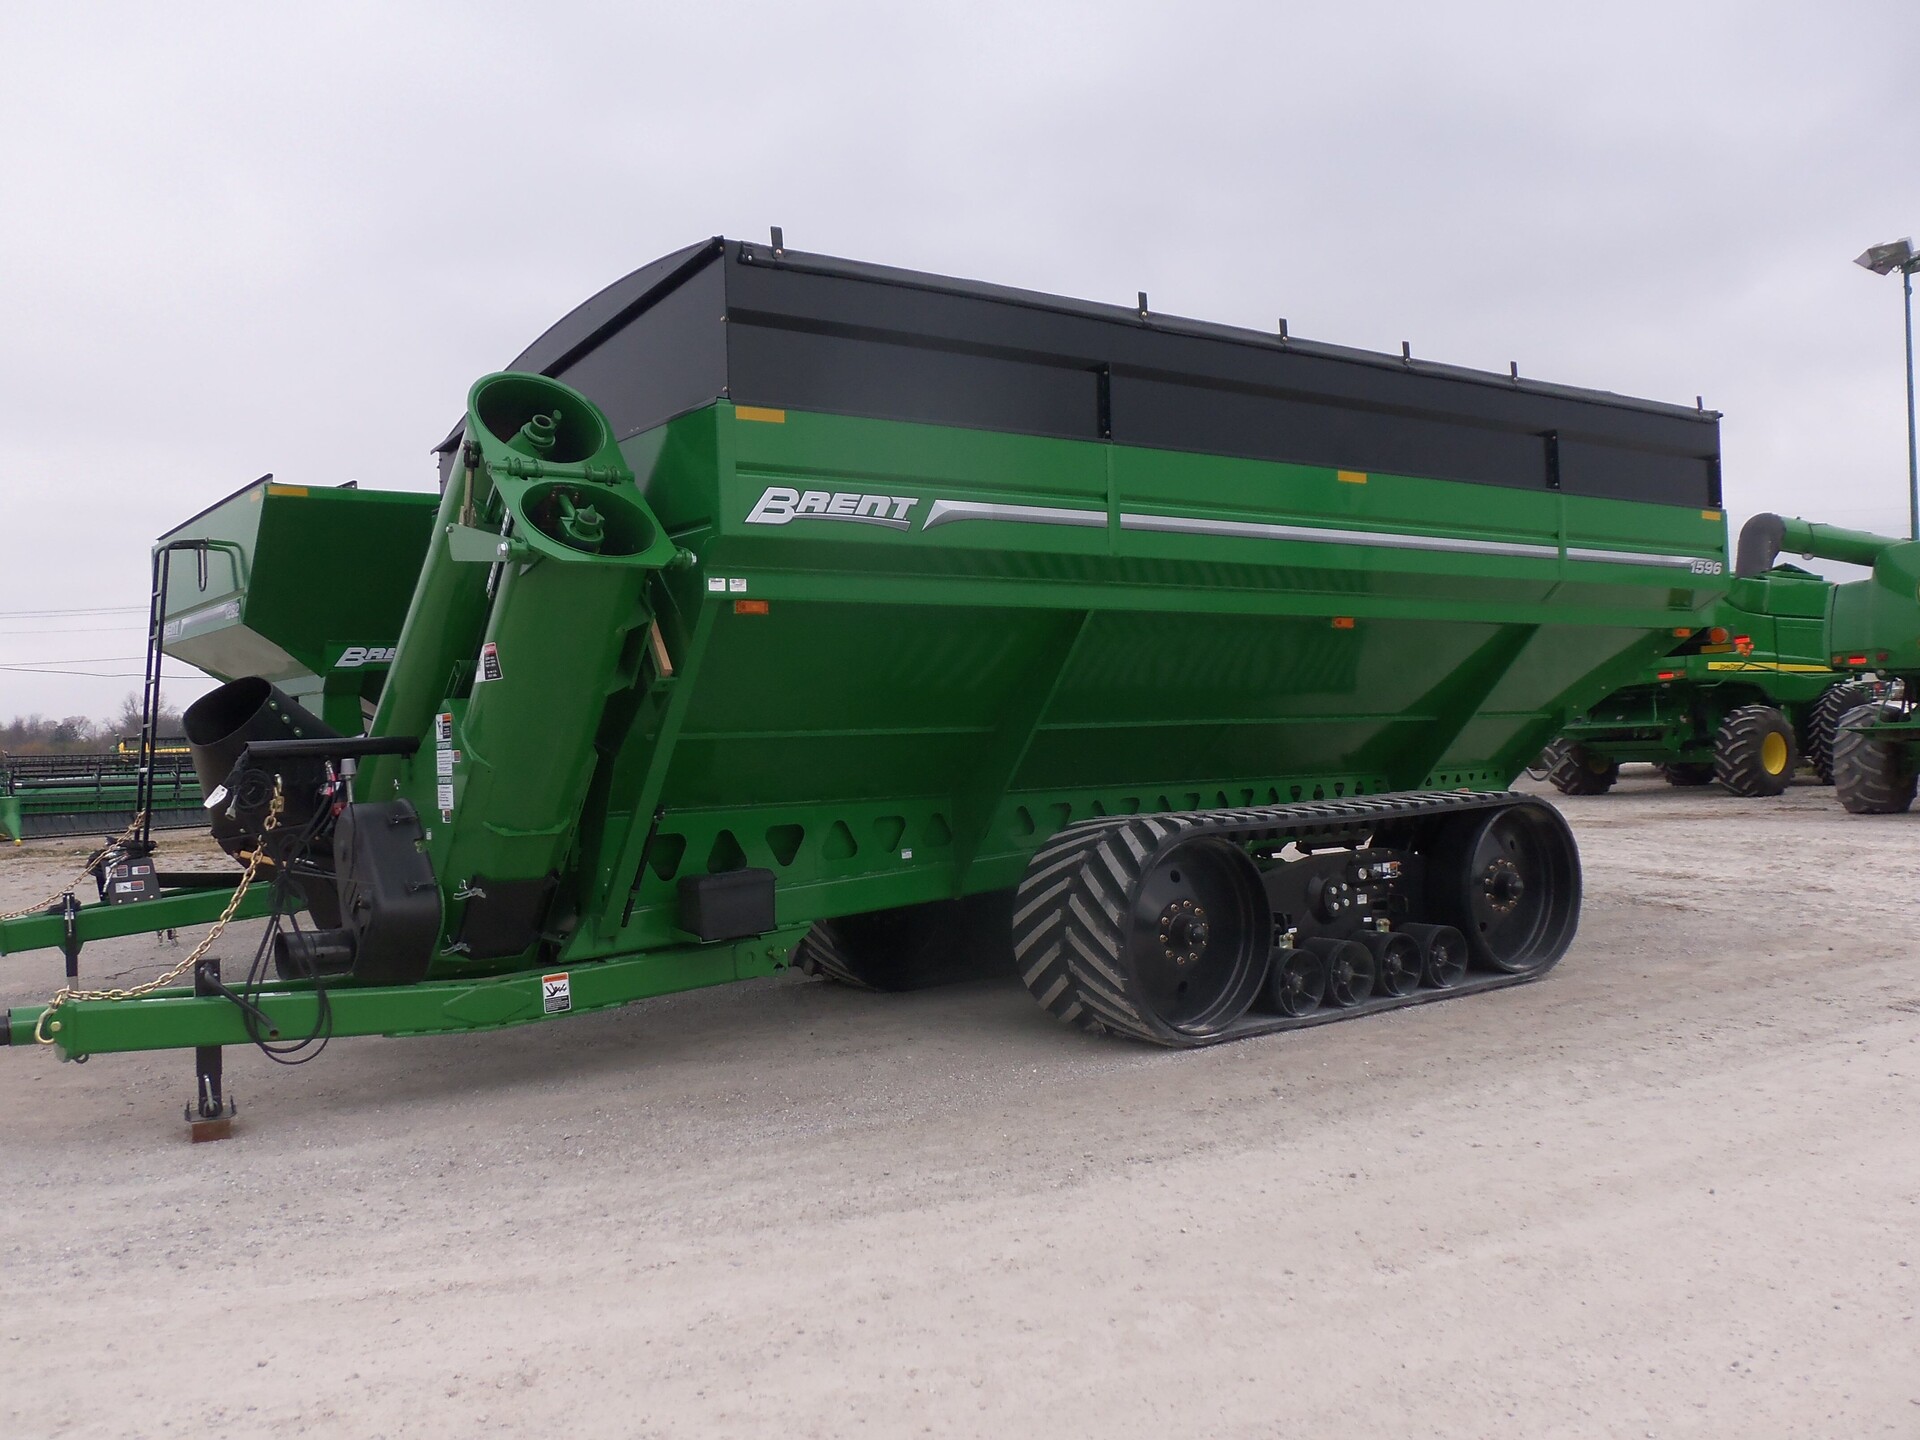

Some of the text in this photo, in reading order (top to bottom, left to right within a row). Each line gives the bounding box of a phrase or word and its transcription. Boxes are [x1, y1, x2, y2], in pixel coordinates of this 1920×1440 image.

[745, 486, 919, 525] BRENT
[1690, 560, 1722, 575] 1596
[334, 647, 397, 667] BRE
